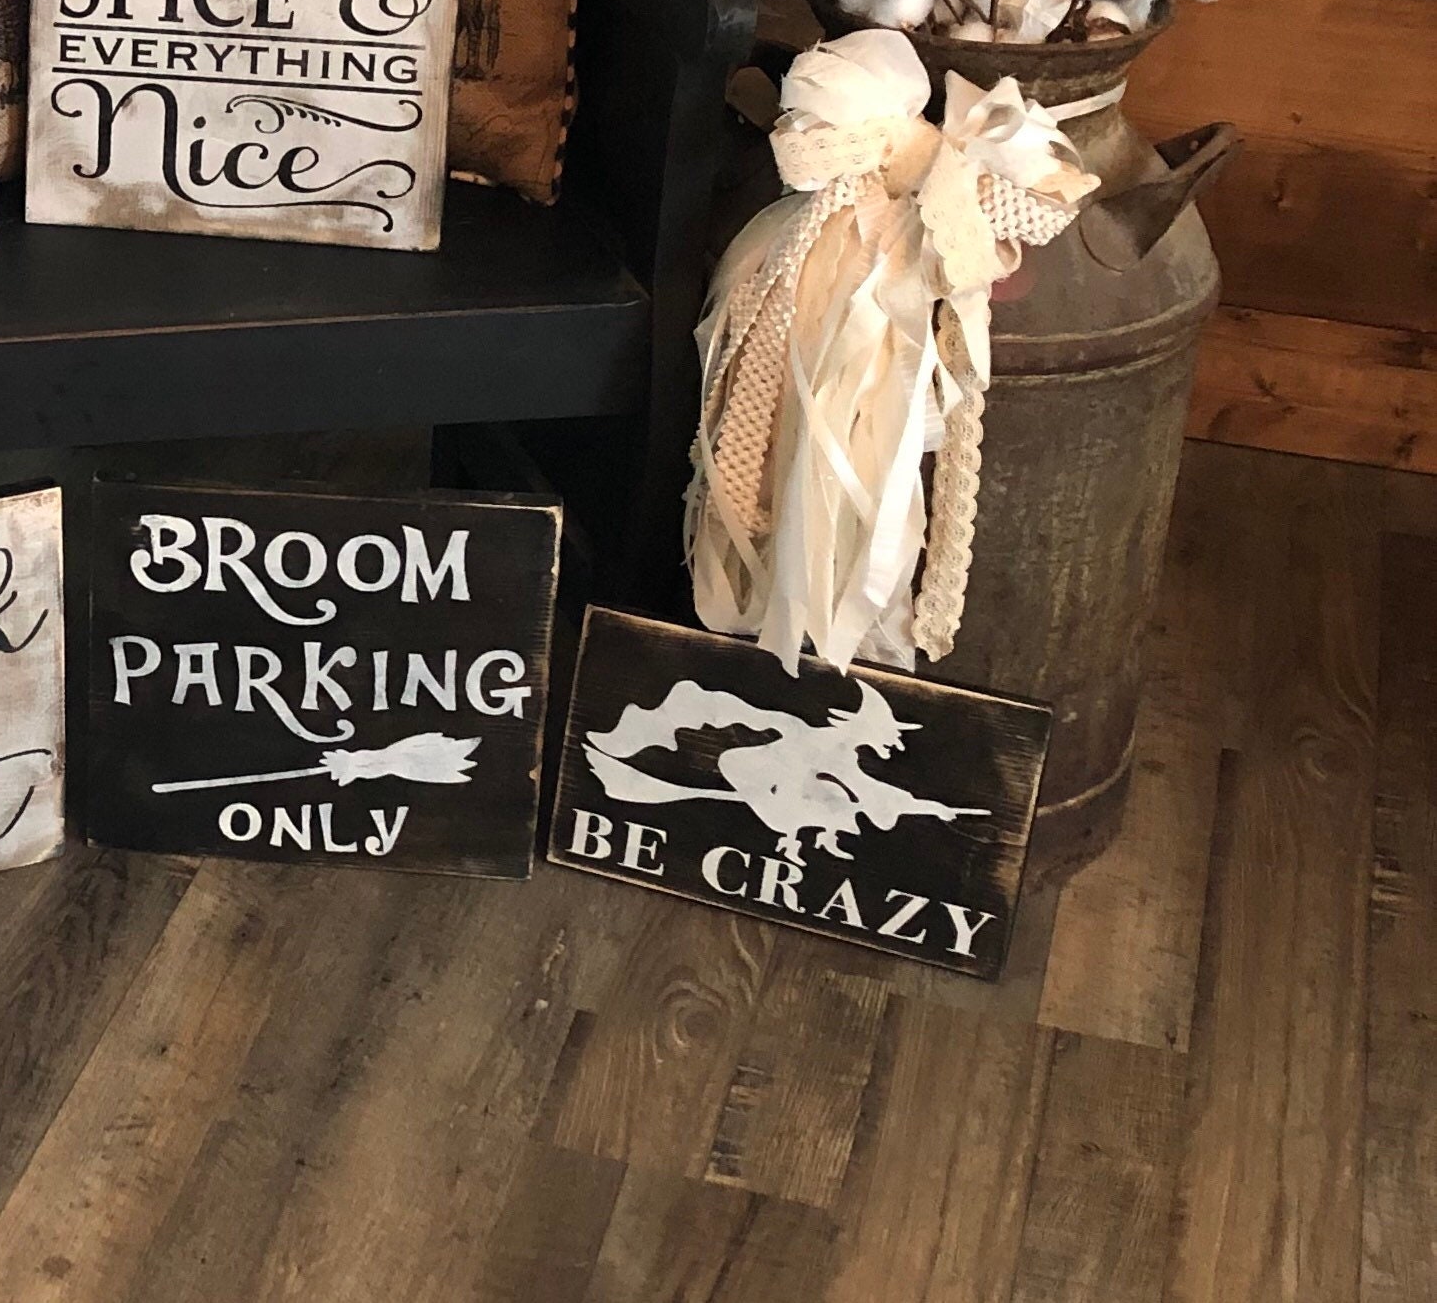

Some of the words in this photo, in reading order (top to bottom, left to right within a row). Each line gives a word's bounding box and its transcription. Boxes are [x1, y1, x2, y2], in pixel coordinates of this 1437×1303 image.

[59, 33, 419, 85] EVERYTHING
[130, 513, 470, 626] BROOM
[109, 634, 532, 743] PARKING
[565, 808, 668, 876] BE
[701, 845, 997, 959] CRAZY
